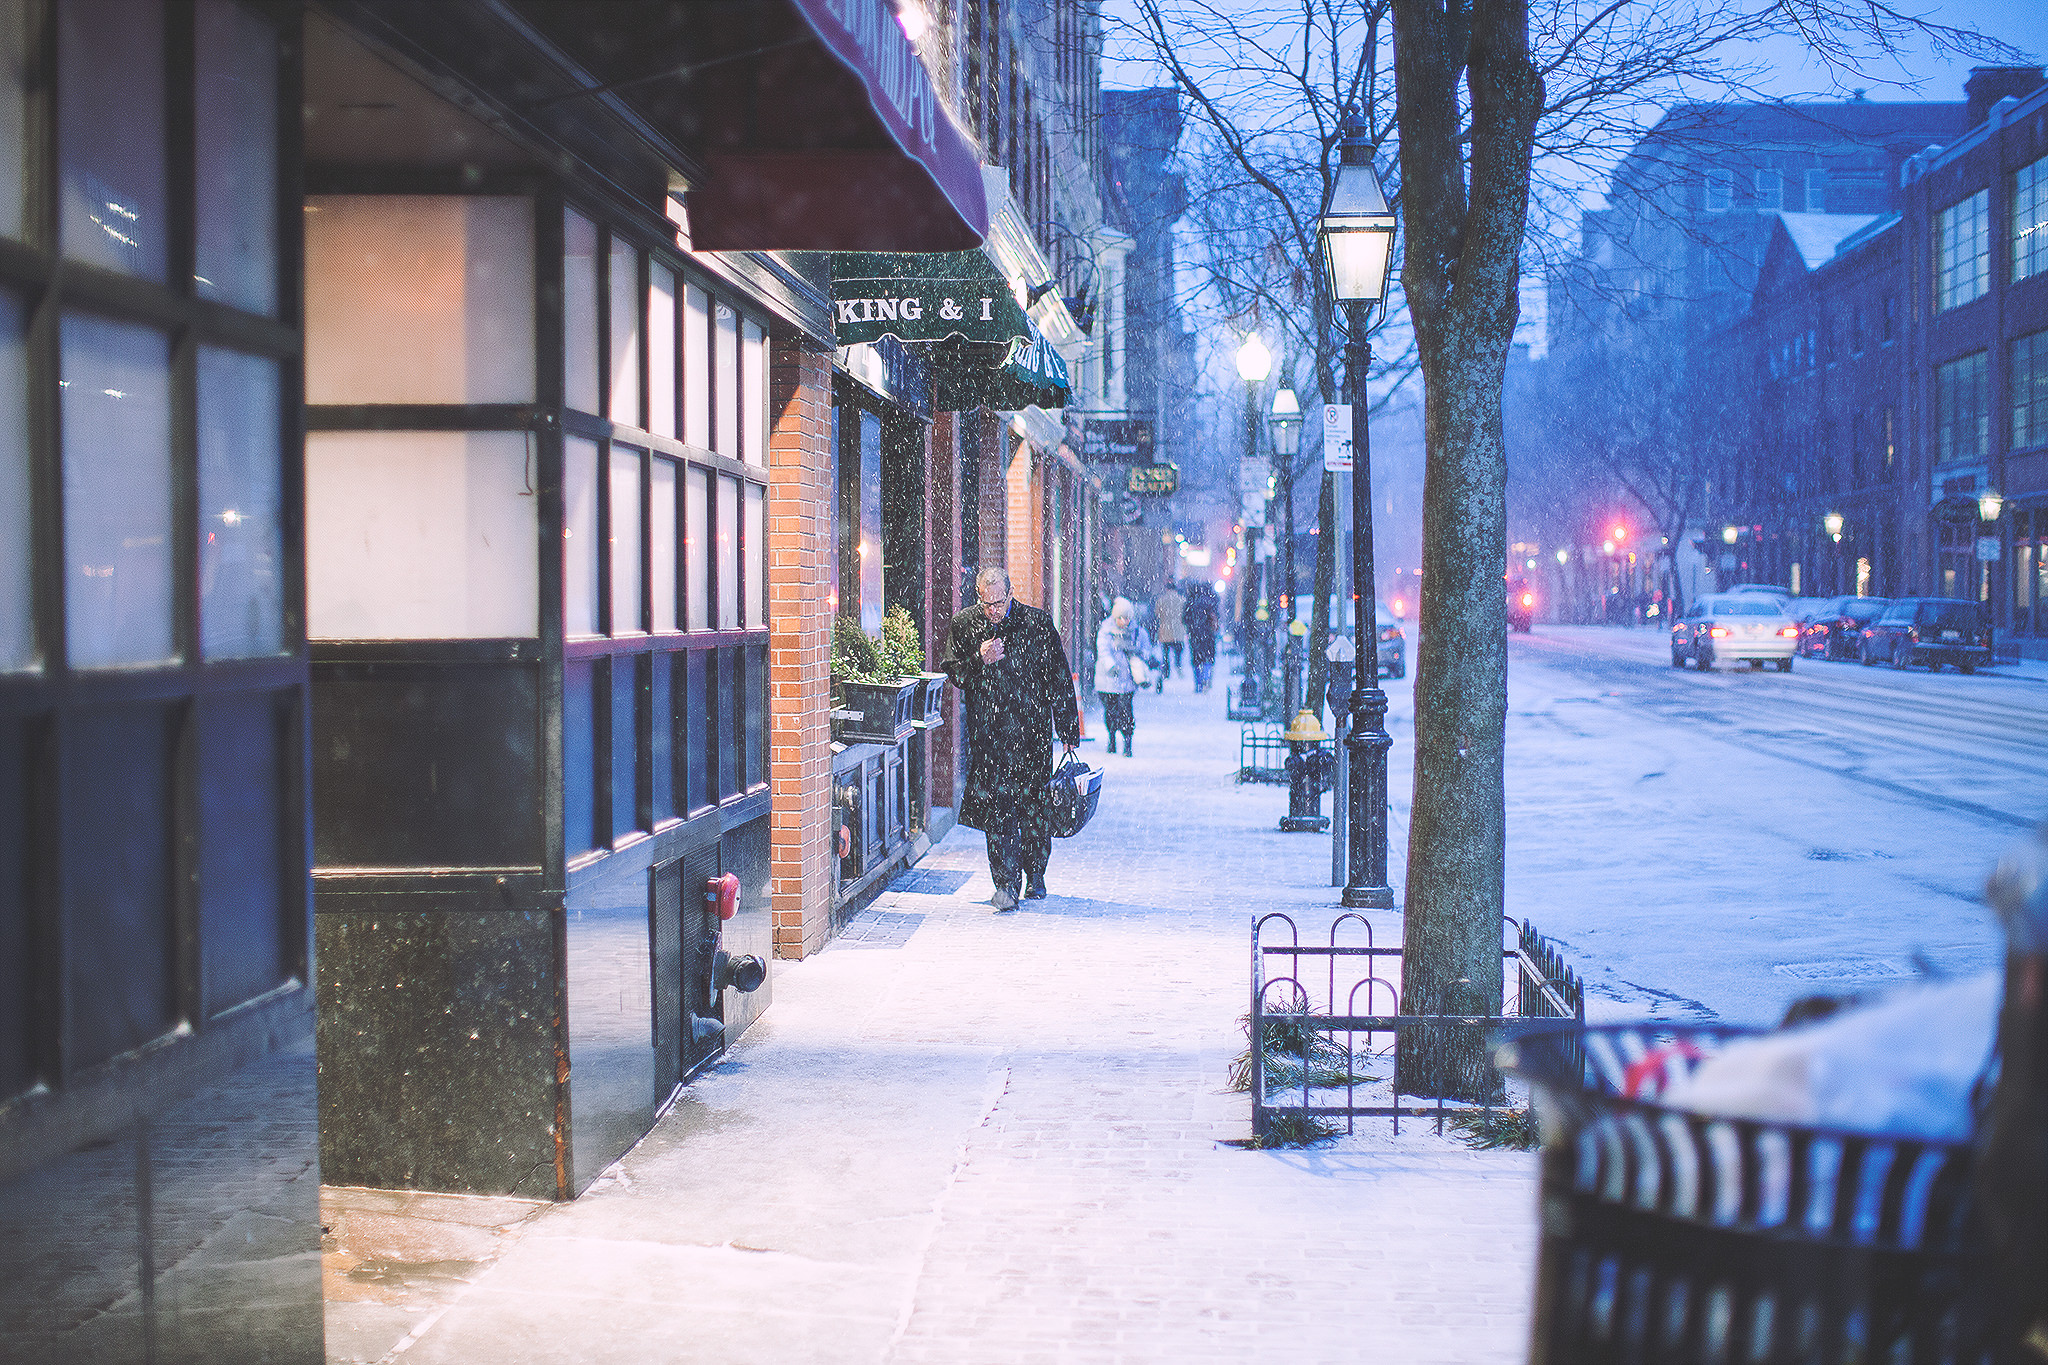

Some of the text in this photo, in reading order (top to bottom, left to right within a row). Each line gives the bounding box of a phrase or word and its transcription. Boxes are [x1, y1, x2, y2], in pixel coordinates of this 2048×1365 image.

[835, 297, 993, 323] KING & I
